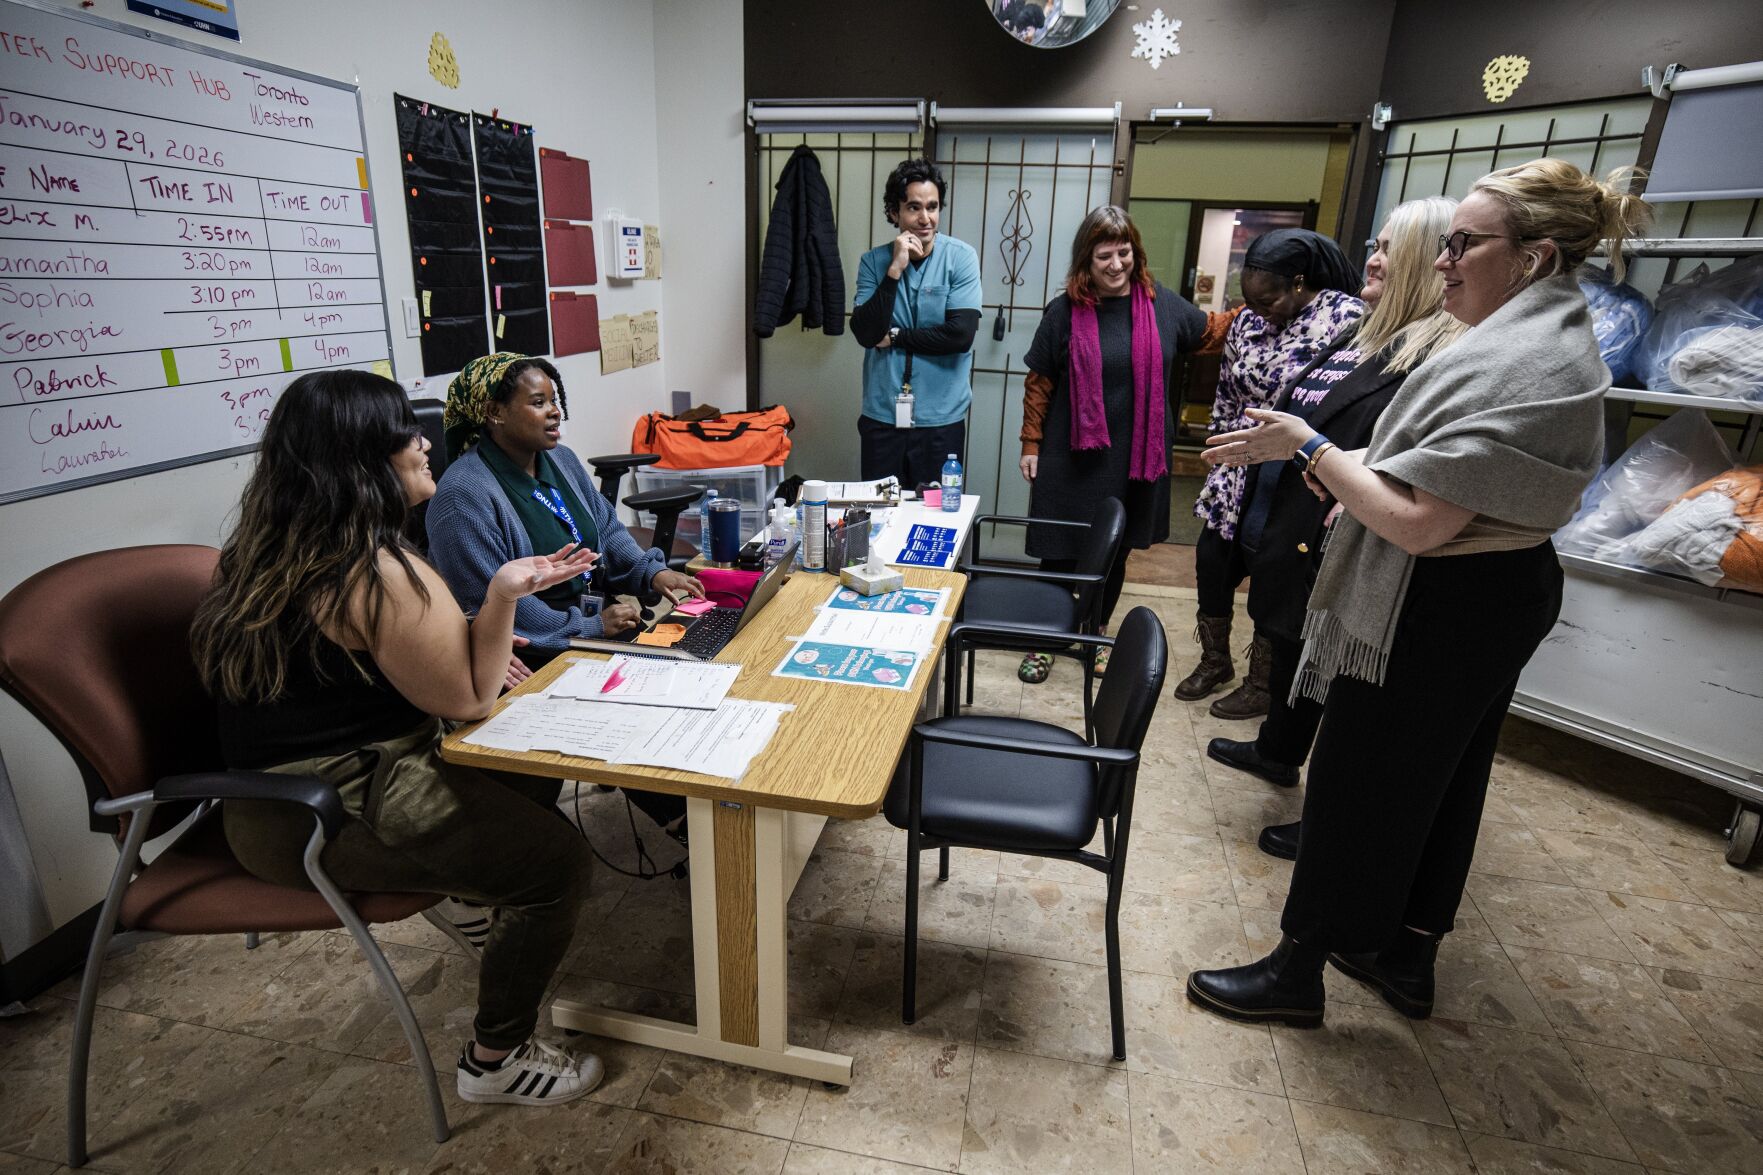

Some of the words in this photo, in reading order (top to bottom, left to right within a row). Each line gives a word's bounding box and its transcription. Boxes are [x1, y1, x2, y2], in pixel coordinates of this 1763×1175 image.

[63, 37, 175, 87] SUPPORT
[189, 70, 231, 101] HUB
[243, 71, 310, 106] Toronto
[249, 103, 314, 129] Western
[166, 140, 225, 167] 2026
[139, 175, 194, 201] TIME
[202, 182, 235, 204] IN
[319, 195, 350, 212] OUT
[300, 226, 342, 250] 12am
